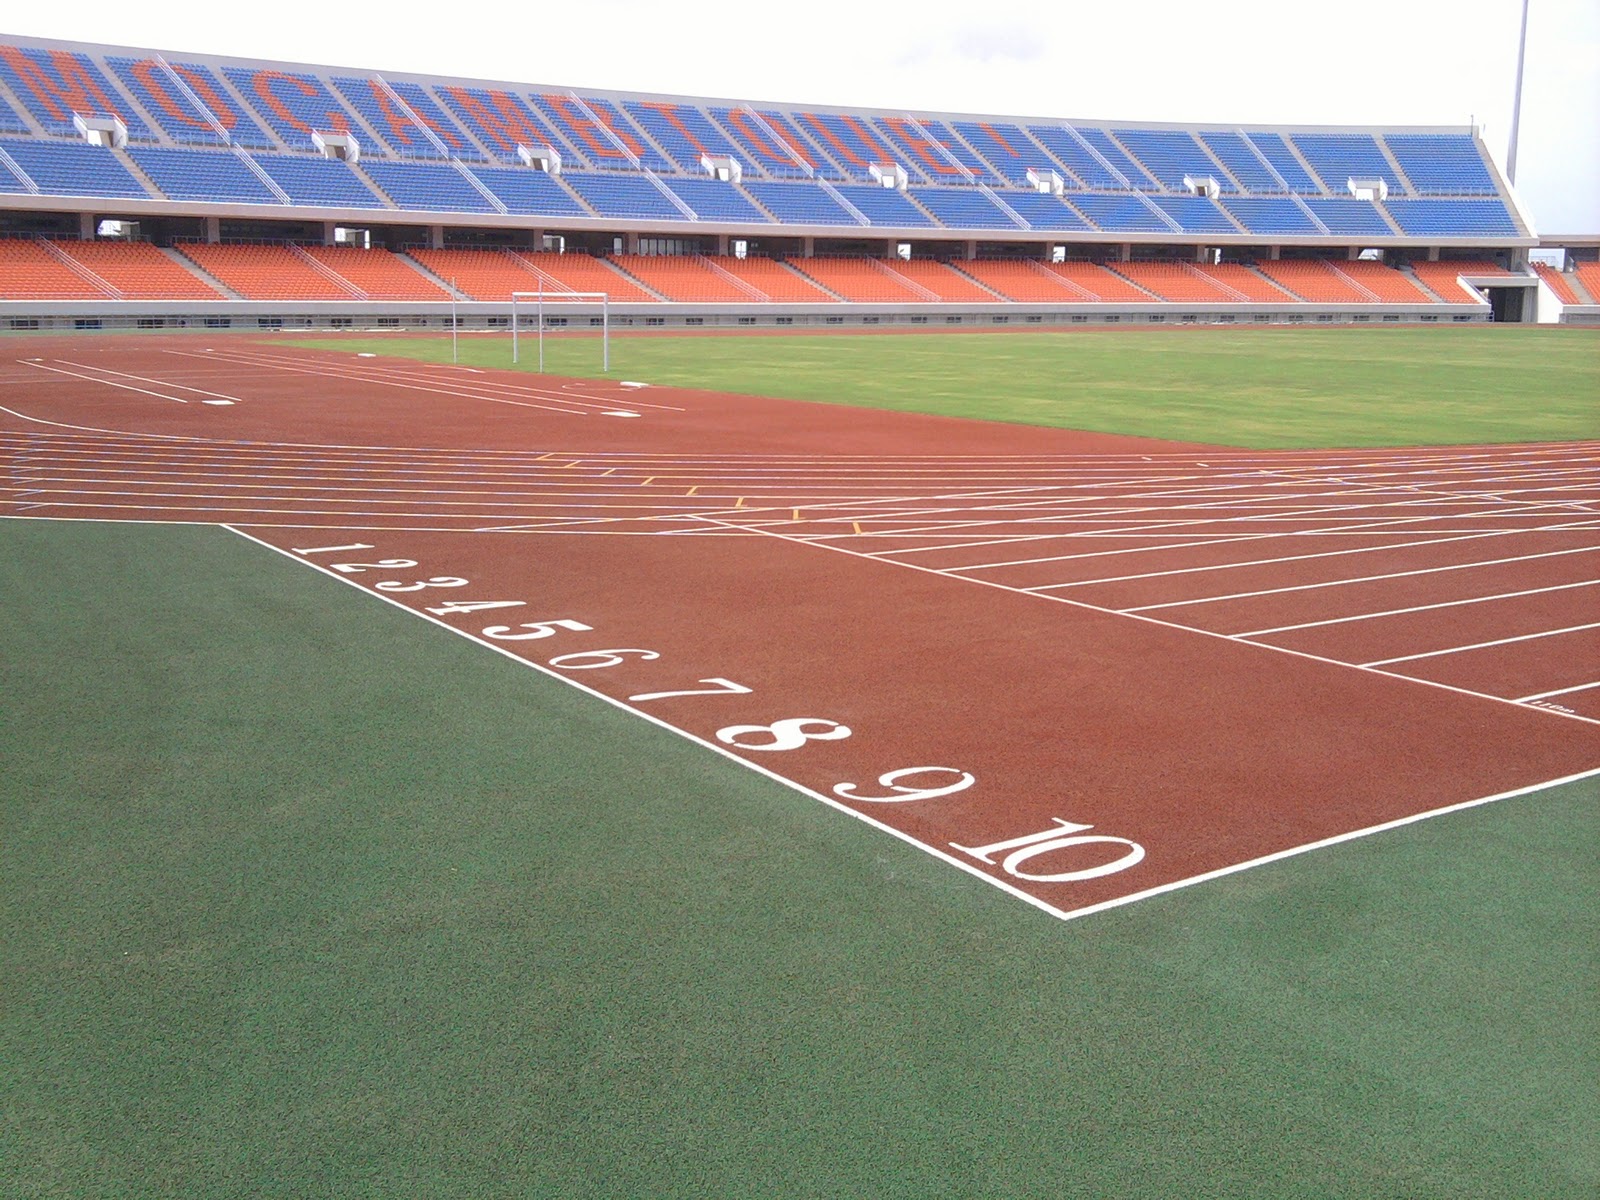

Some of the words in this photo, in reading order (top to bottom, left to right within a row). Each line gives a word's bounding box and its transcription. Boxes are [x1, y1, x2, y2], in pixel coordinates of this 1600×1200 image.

[291, 543, 375, 555] 1
[329, 559, 419, 573] 2
[374, 576, 469, 592] 3
[424, 600, 527, 616] 4
[481, 619, 594, 640] 5
[548, 648, 660, 670] 6
[628, 677, 754, 702] 7
[715, 717, 852, 751] 8
[832, 766, 976, 803] 9
[948, 817, 1146, 883] 10
